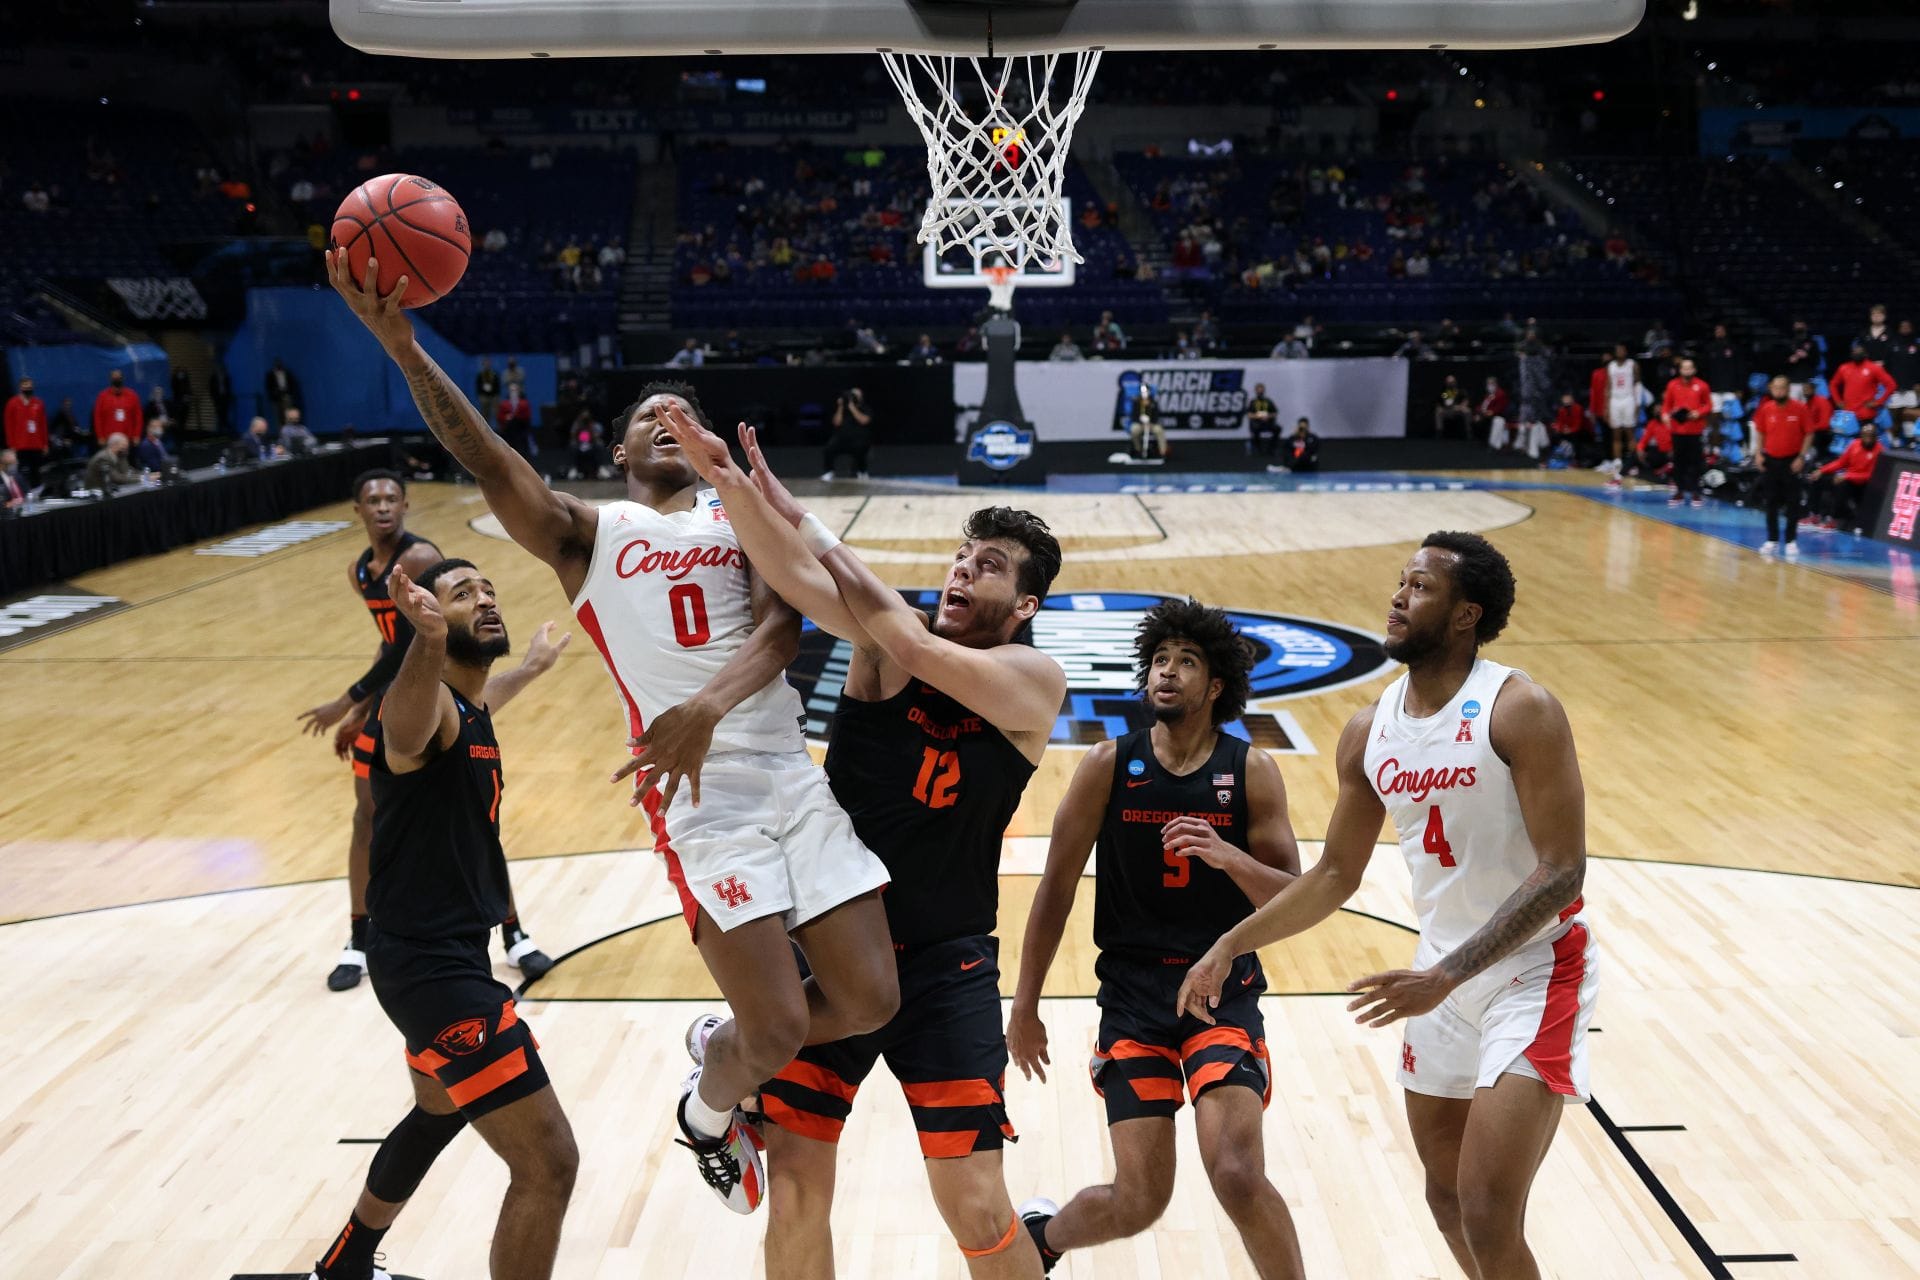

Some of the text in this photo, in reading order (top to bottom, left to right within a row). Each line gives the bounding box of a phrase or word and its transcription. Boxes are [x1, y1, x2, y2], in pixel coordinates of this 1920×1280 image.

[1141, 371, 1212, 392] MARCH
[1155, 391, 1244, 412] MADNESS
[615, 539, 744, 581] Cougars
[668, 583, 711, 648] 0
[912, 745, 961, 808] 12
[1376, 757, 1476, 802] Cougars
[1423, 805, 1457, 867] 4
[1163, 838, 1190, 887] 5
